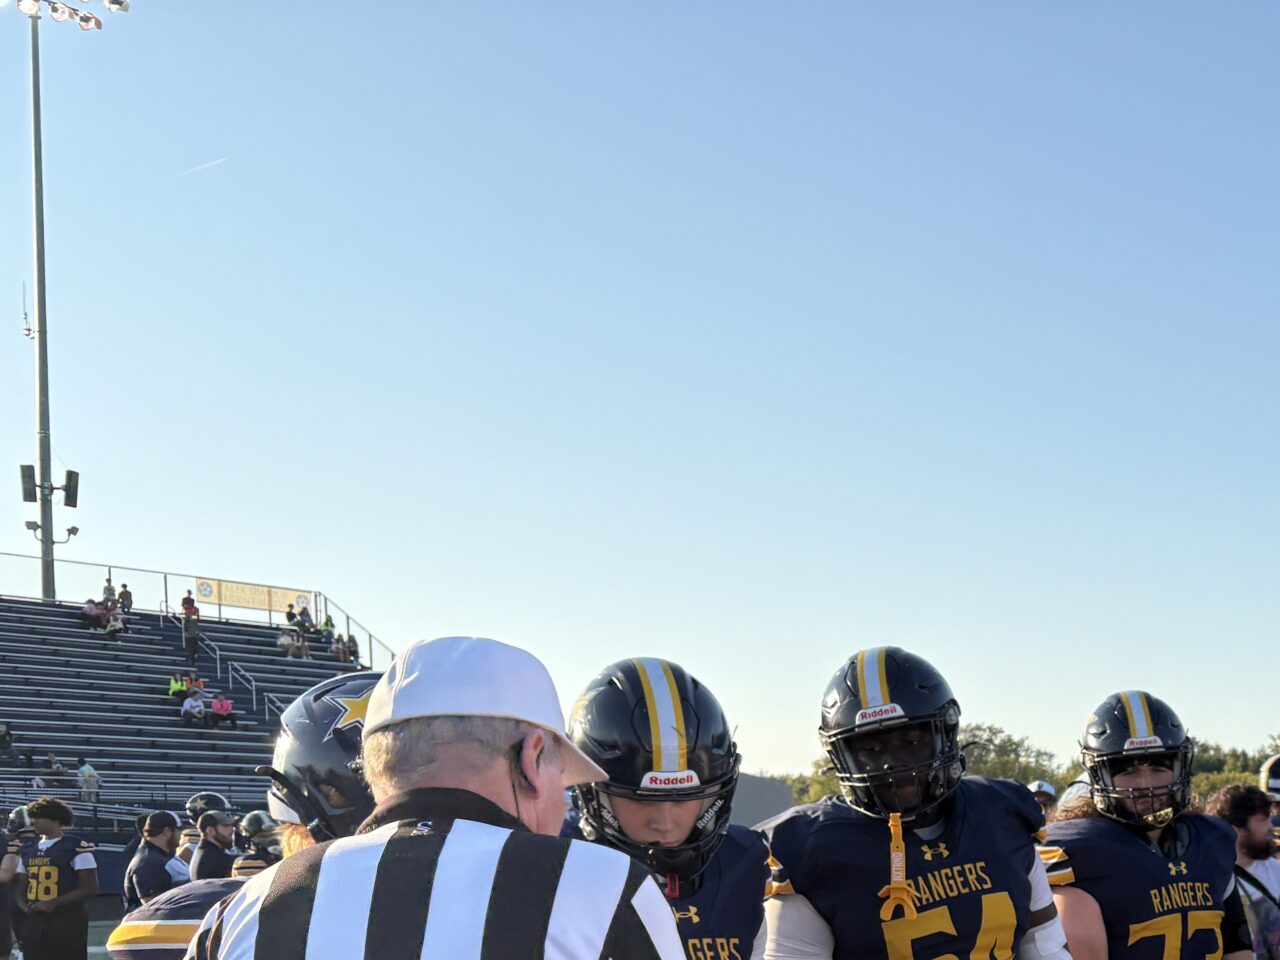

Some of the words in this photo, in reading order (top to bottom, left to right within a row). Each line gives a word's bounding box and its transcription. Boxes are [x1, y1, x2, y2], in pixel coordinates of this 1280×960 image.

[860, 705, 898, 721] Riddell
[649, 774, 694, 786] Riddell
[696, 799, 724, 830] Riddell
[905, 860, 993, 908] RANGERS
[1149, 881, 1214, 913] RANGERS
